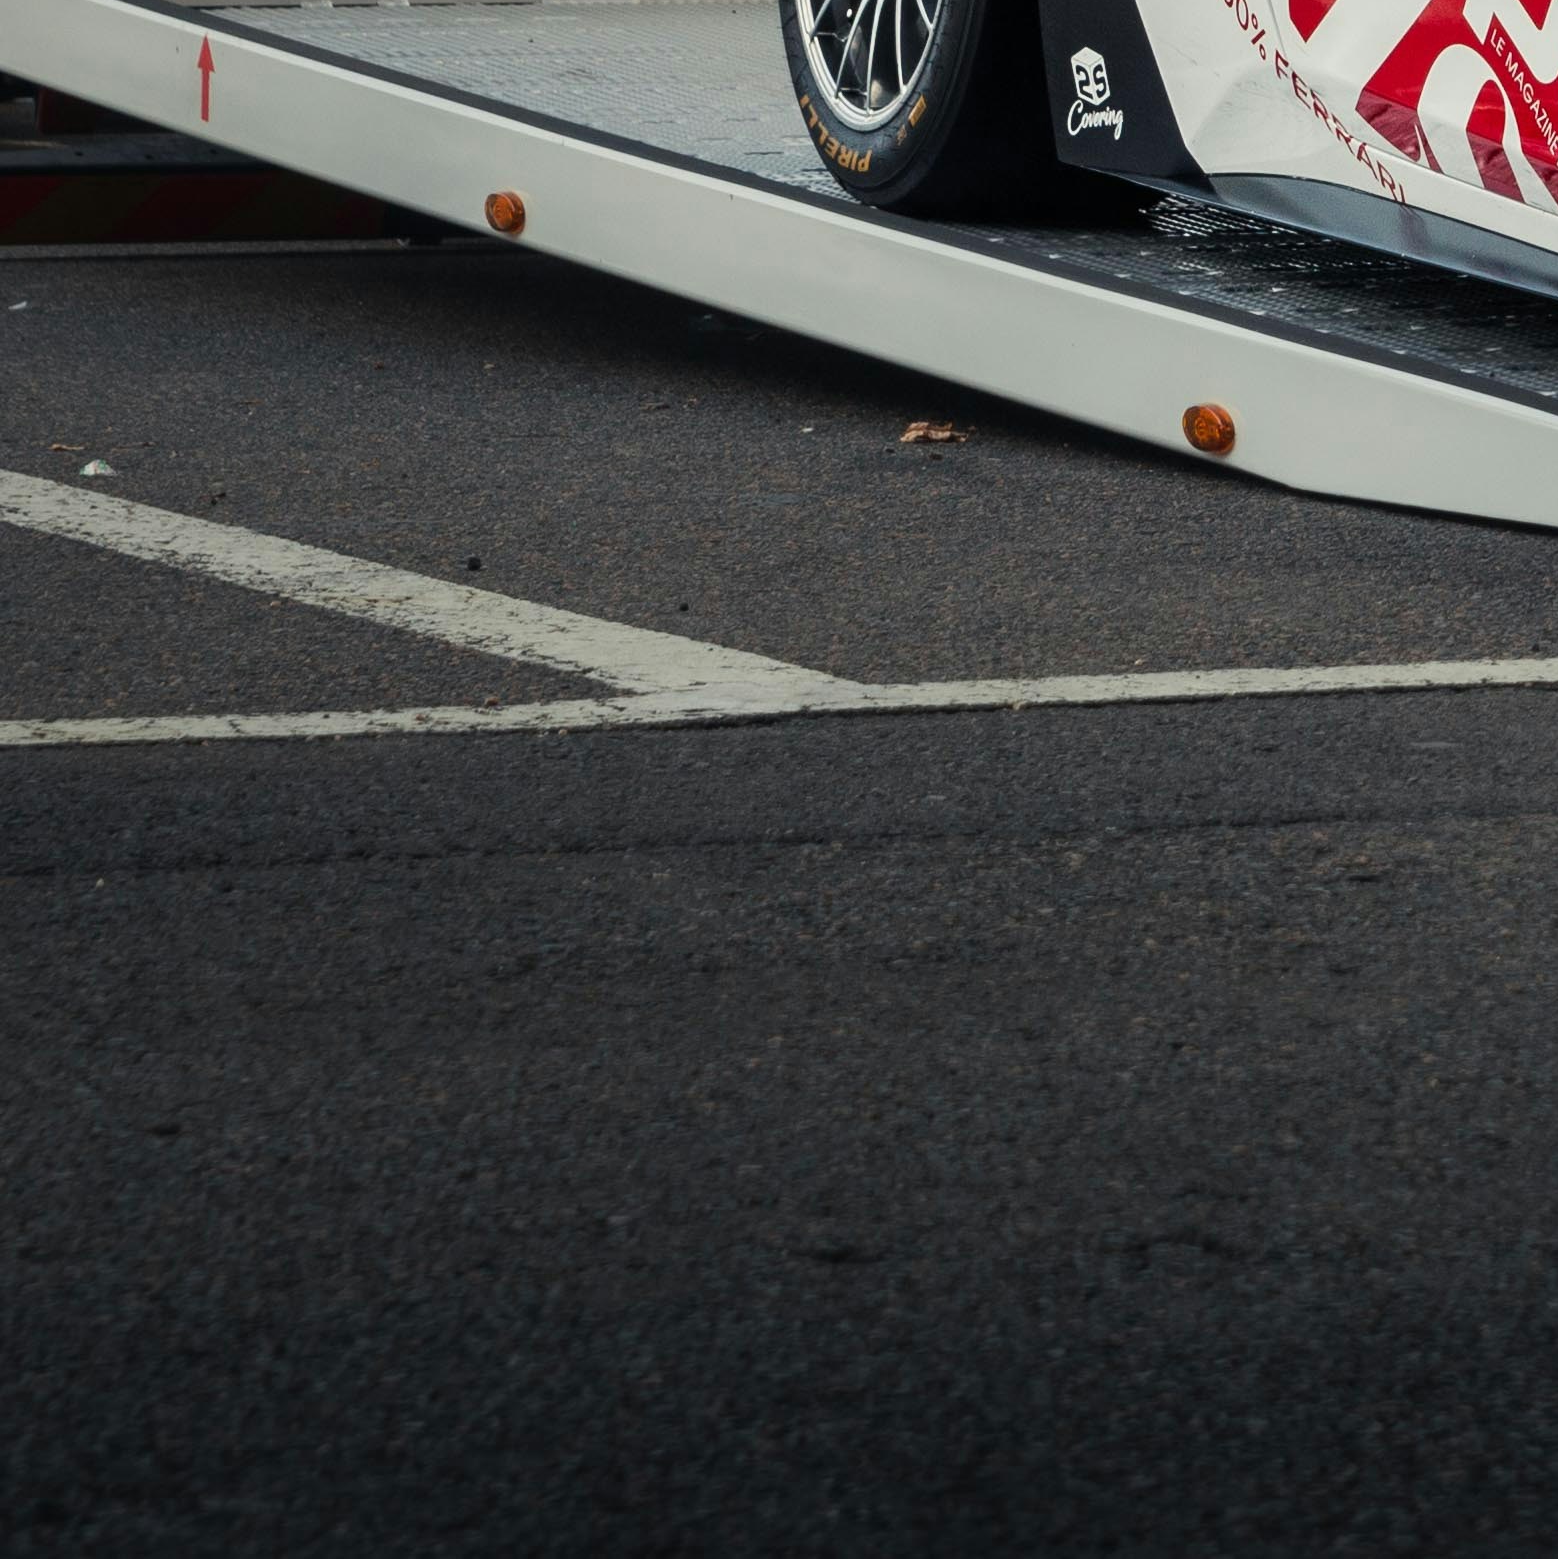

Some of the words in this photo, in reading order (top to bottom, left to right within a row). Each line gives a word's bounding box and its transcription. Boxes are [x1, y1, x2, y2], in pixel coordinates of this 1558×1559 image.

[1490, 27, 1506, 57] LE
[800, 94, 874, 173] PIRELLI
[1067, 99, 1124, 141] Covering
